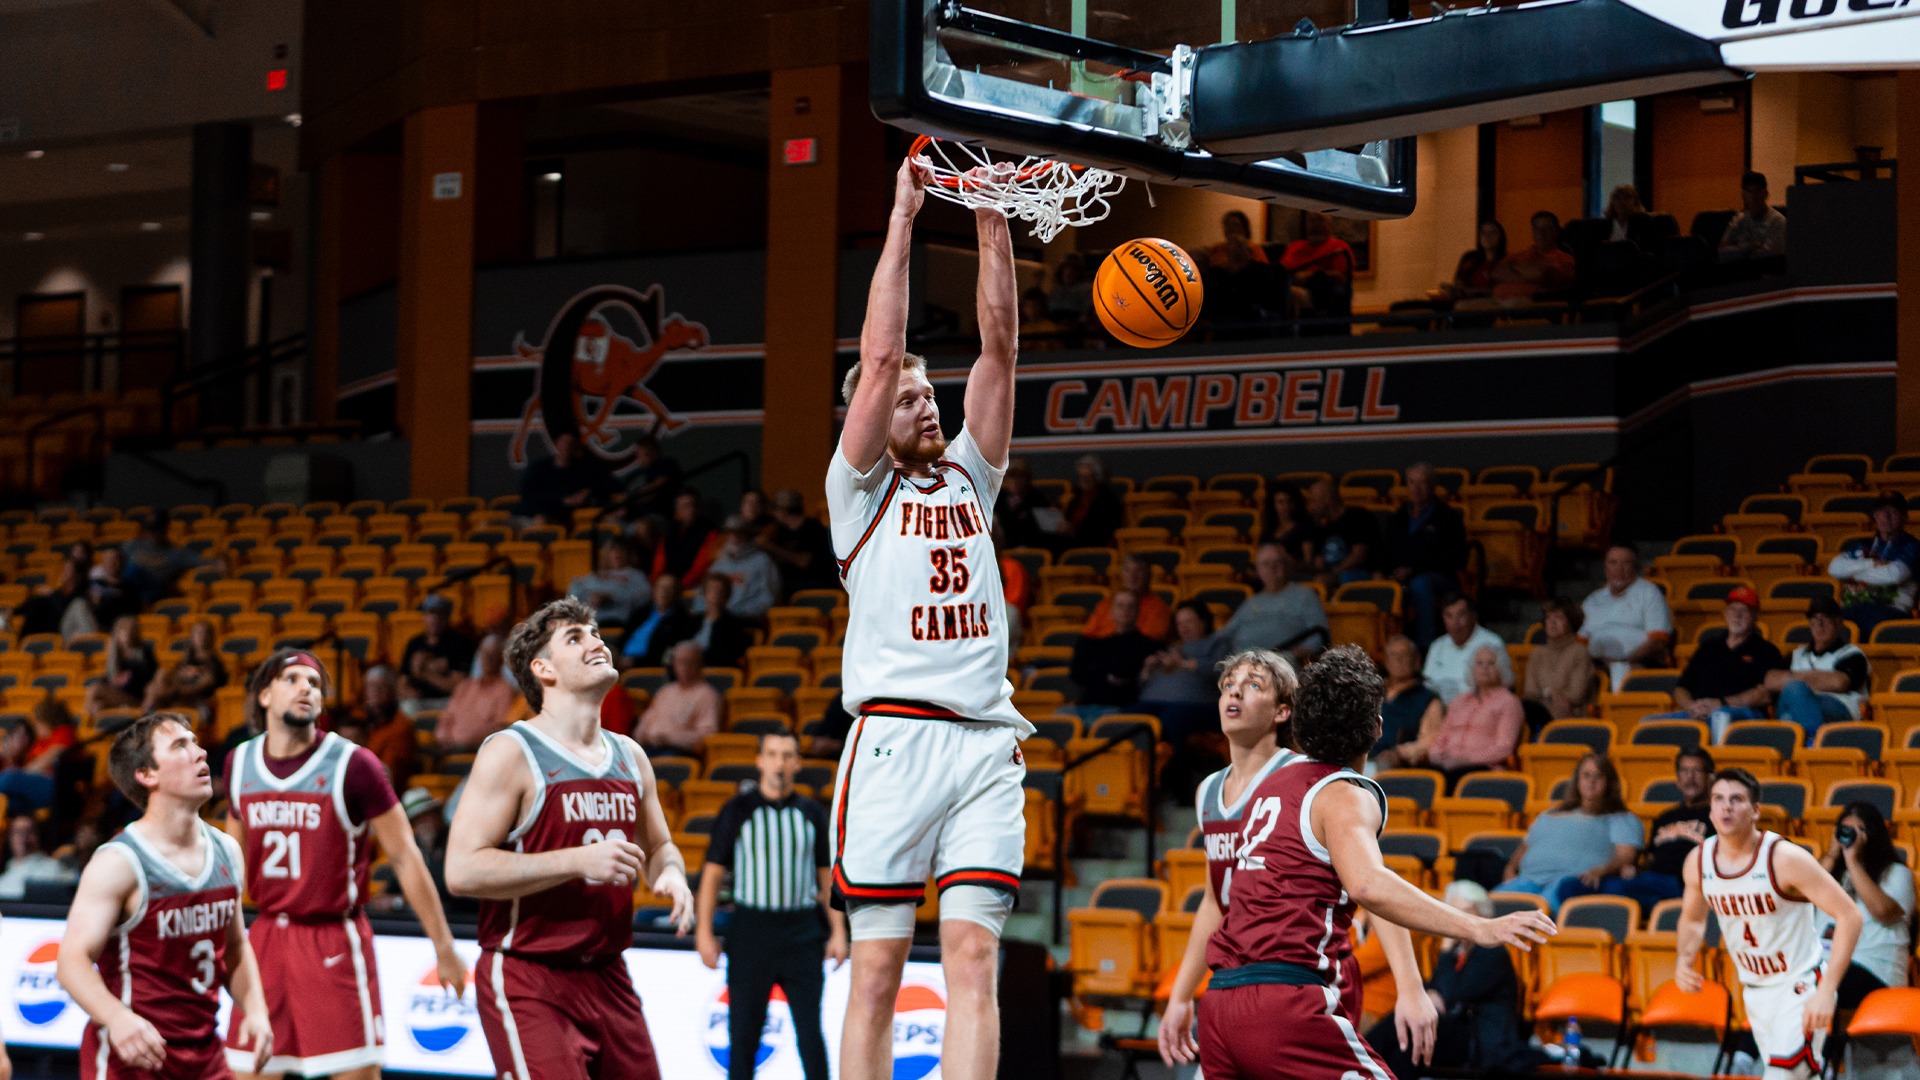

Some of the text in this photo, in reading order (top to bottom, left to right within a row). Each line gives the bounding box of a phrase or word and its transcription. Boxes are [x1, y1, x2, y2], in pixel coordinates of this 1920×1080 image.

[1129, 247, 1180, 312] Wilson
[1044, 367, 1400, 432] CAMPBELL
[899, 500, 983, 540] FIGHING
[929, 547, 970, 594] 35
[911, 602, 989, 641] CAMELS
[247, 800, 321, 830] KNIGHTS
[561, 791, 637, 822] KNIGHTS
[1204, 831, 1240, 861] NIGH
[1235, 796, 1282, 870] 12
[262, 830, 301, 879] 21
[1743, 921, 1759, 948] 4
[18, 971, 64, 990] PEP
[190, 940, 216, 995] 3
[411, 995, 475, 1015] PEPS
[895, 1022, 940, 1046] EPS
